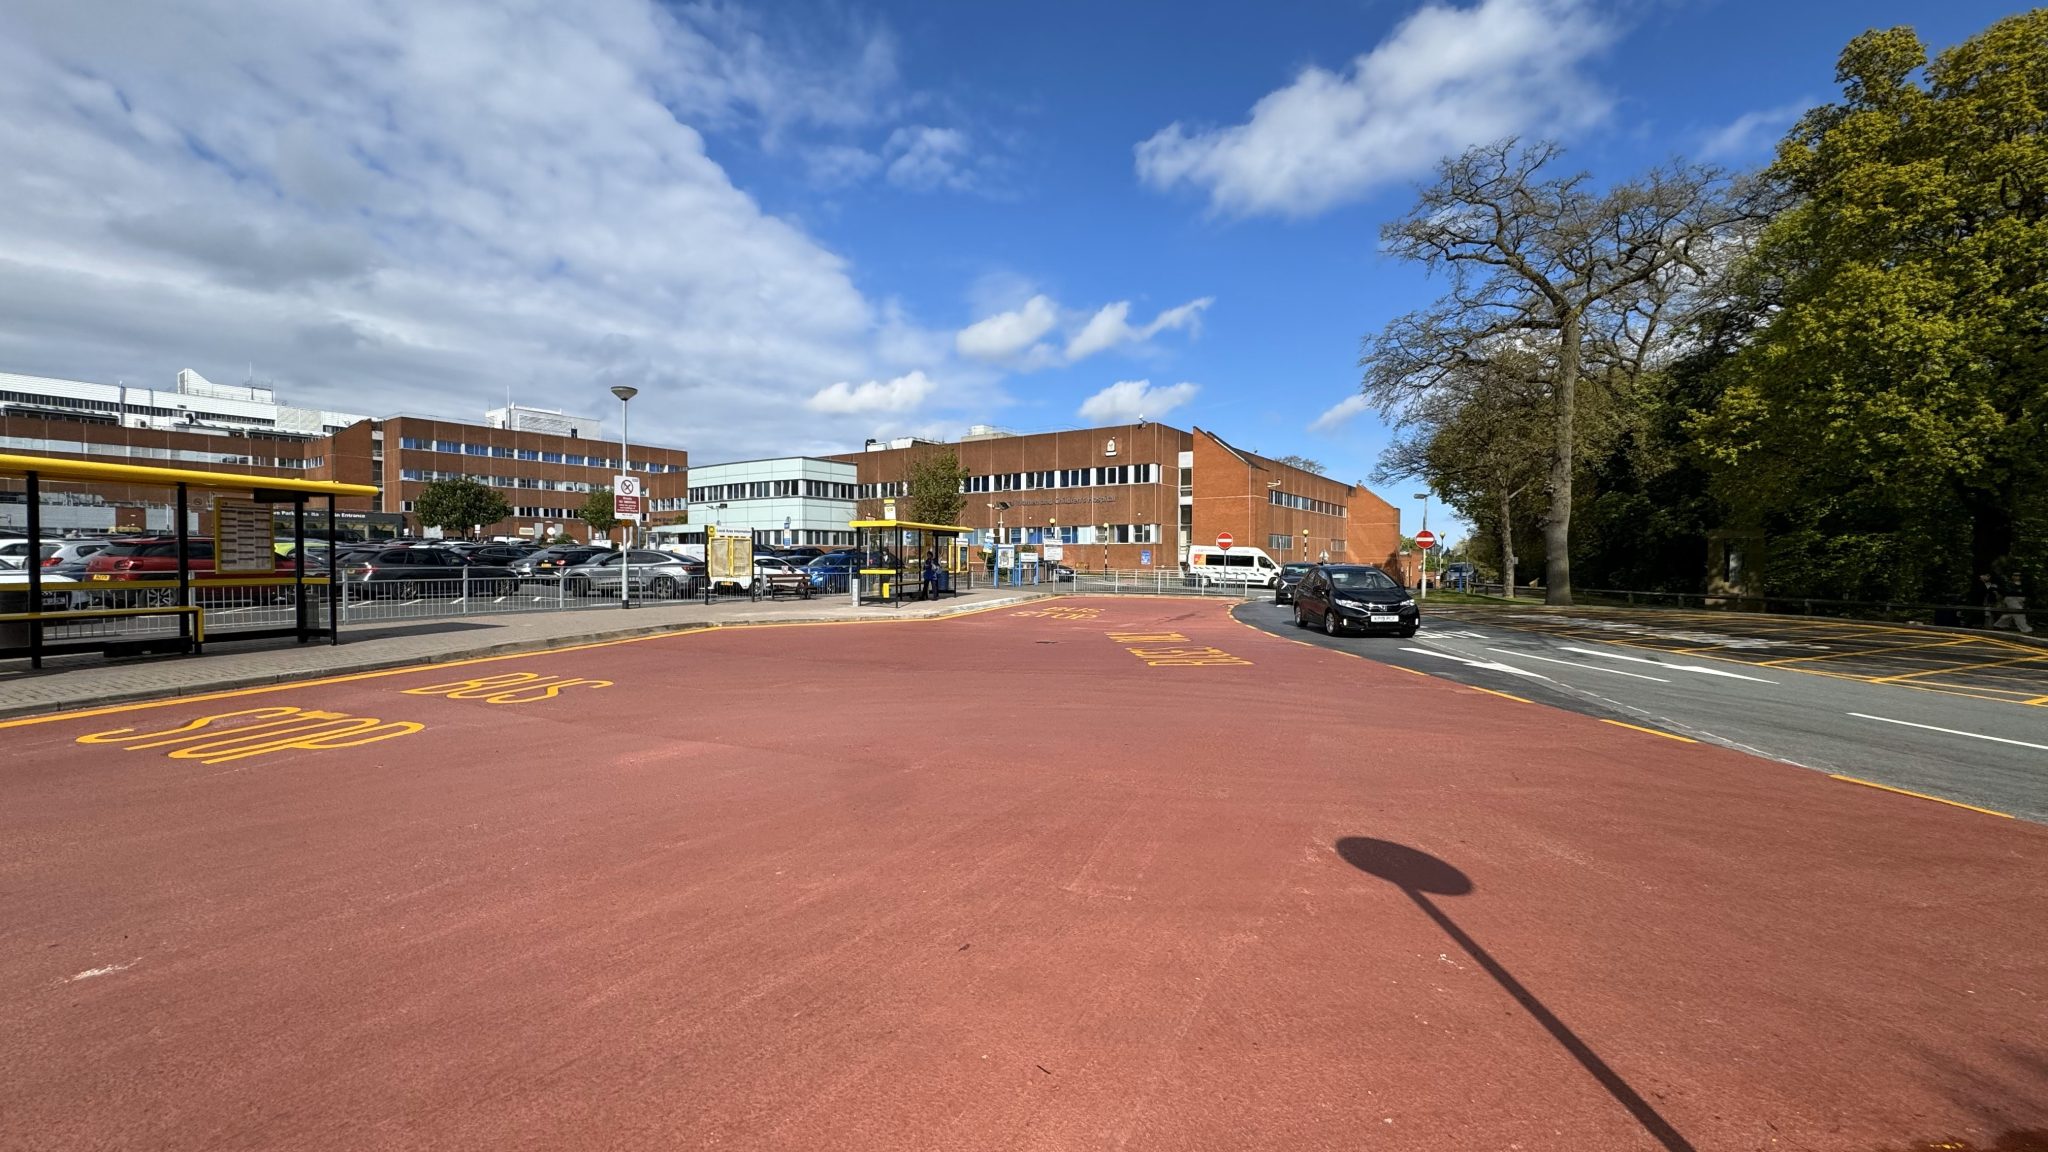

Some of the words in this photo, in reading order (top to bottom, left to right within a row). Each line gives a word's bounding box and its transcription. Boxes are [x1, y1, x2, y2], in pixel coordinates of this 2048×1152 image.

[1088, 495, 1116, 504] Hospital
[1010, 610, 1098, 620] STOP
[400, 672, 614, 704] BUS
[76, 706, 426, 765] STOP
